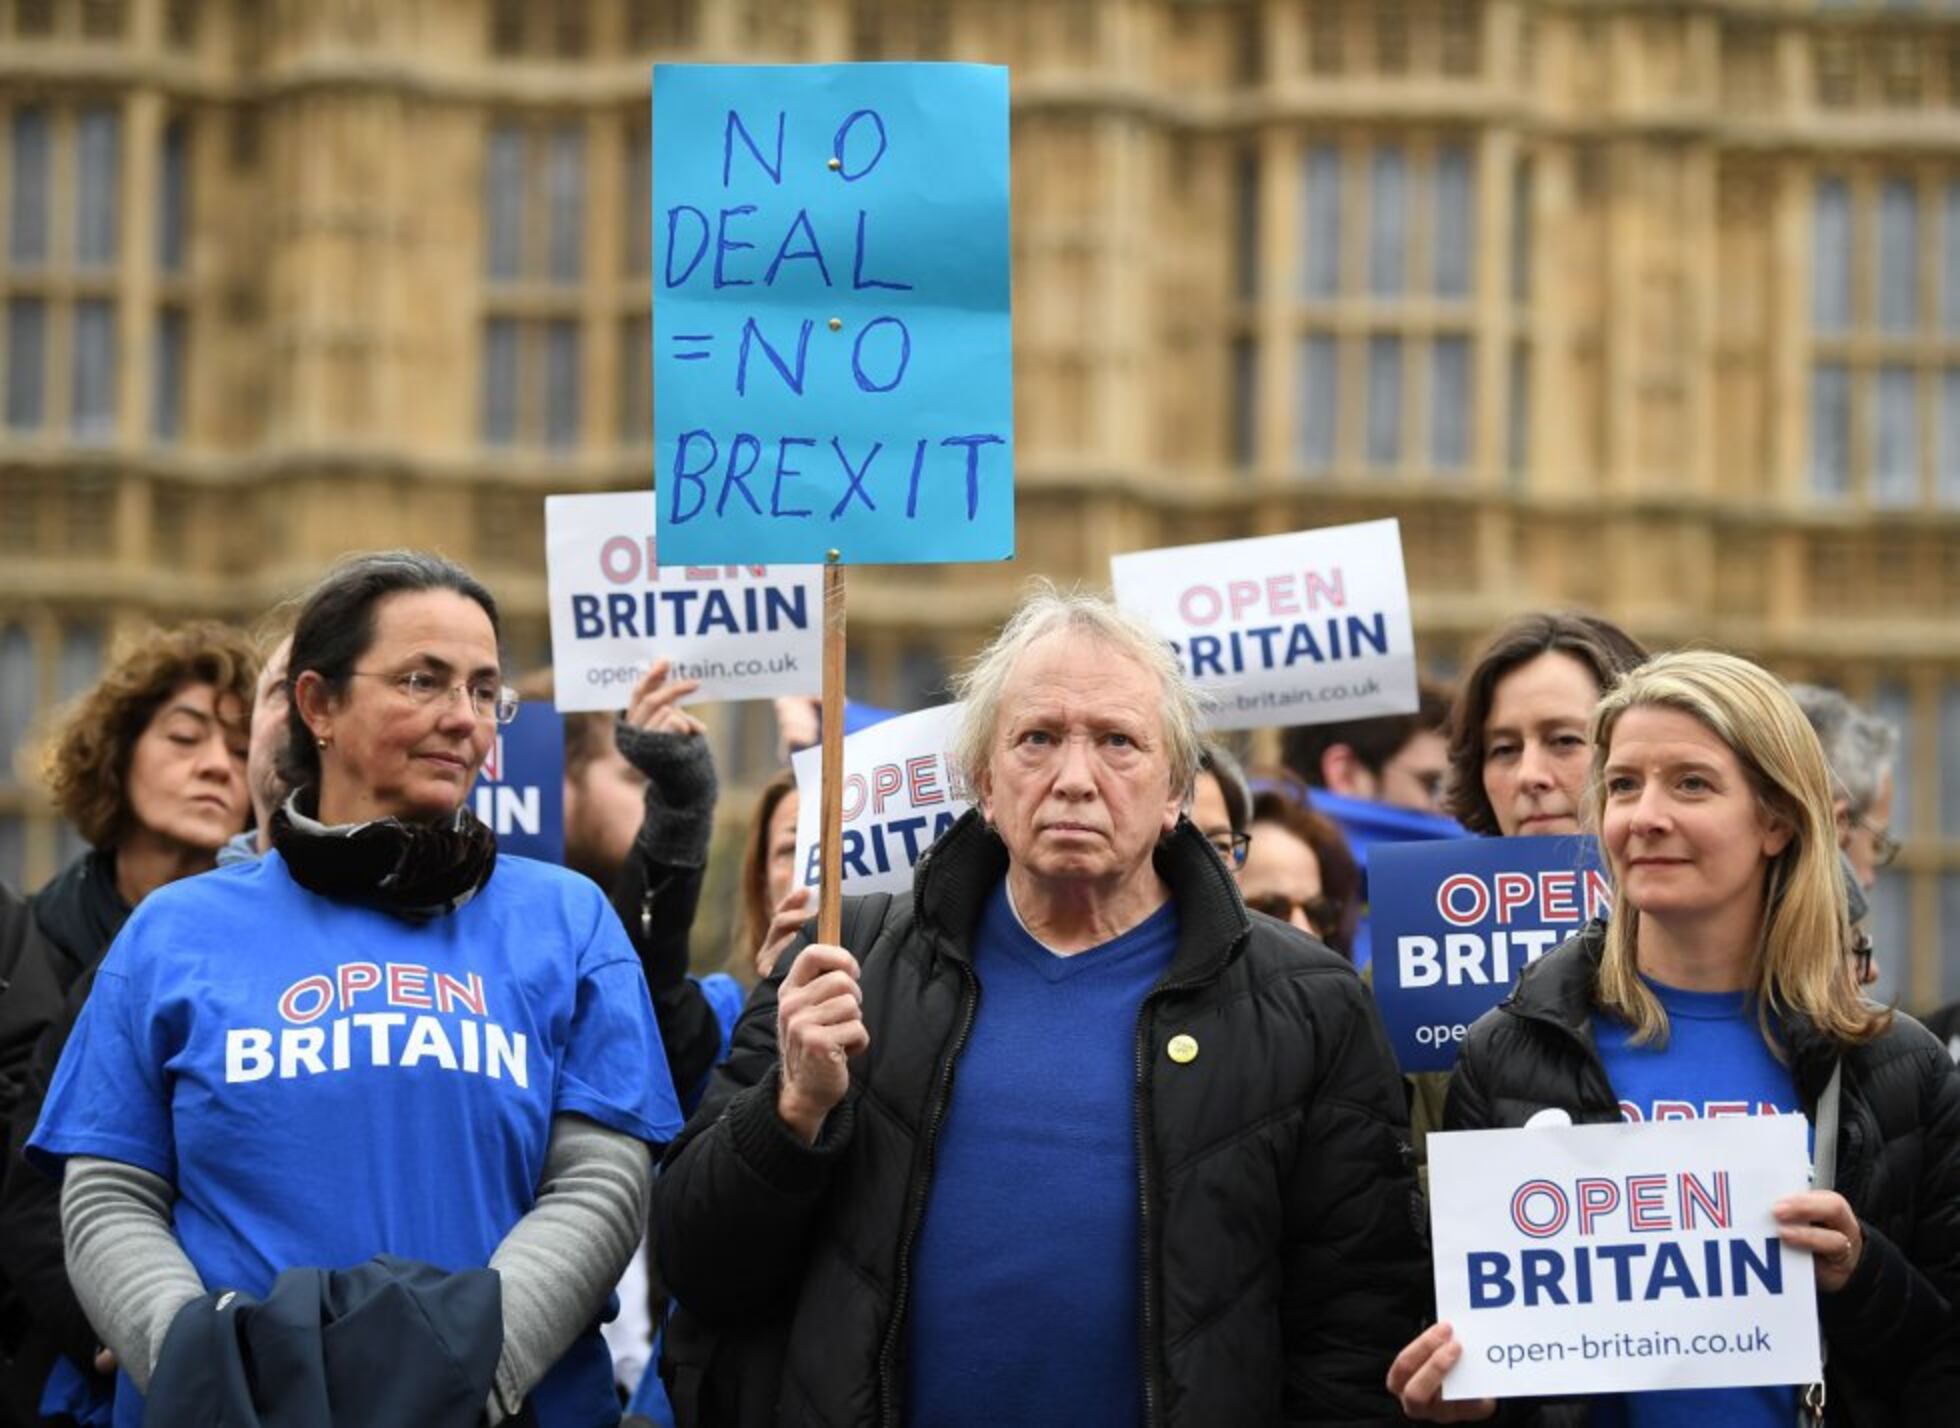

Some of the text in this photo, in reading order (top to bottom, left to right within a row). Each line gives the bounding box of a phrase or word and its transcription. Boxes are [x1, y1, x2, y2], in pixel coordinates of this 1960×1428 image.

[724, 109, 887, 187] NO
[665, 205, 912, 290] DEAL
[669, 429, 1005, 524] BREXIT
[571, 585, 808, 639] BRITAIN
[1178, 566, 1346, 627] OPEN
[587, 653, 799, 686] open-itain.co.uk
[1168, 613, 1389, 677] RITAIN
[1398, 930, 1578, 988] BRIT
[278, 961, 488, 1025] OPEN
[225, 1012, 528, 1089] BRITAIN
[1415, 1023, 1472, 1049] ope
[1510, 1171, 1732, 1238] OPEN
[1466, 1237, 1784, 1309] BRITAIN
[1486, 1325, 1771, 1369] open-britain.co.uk
